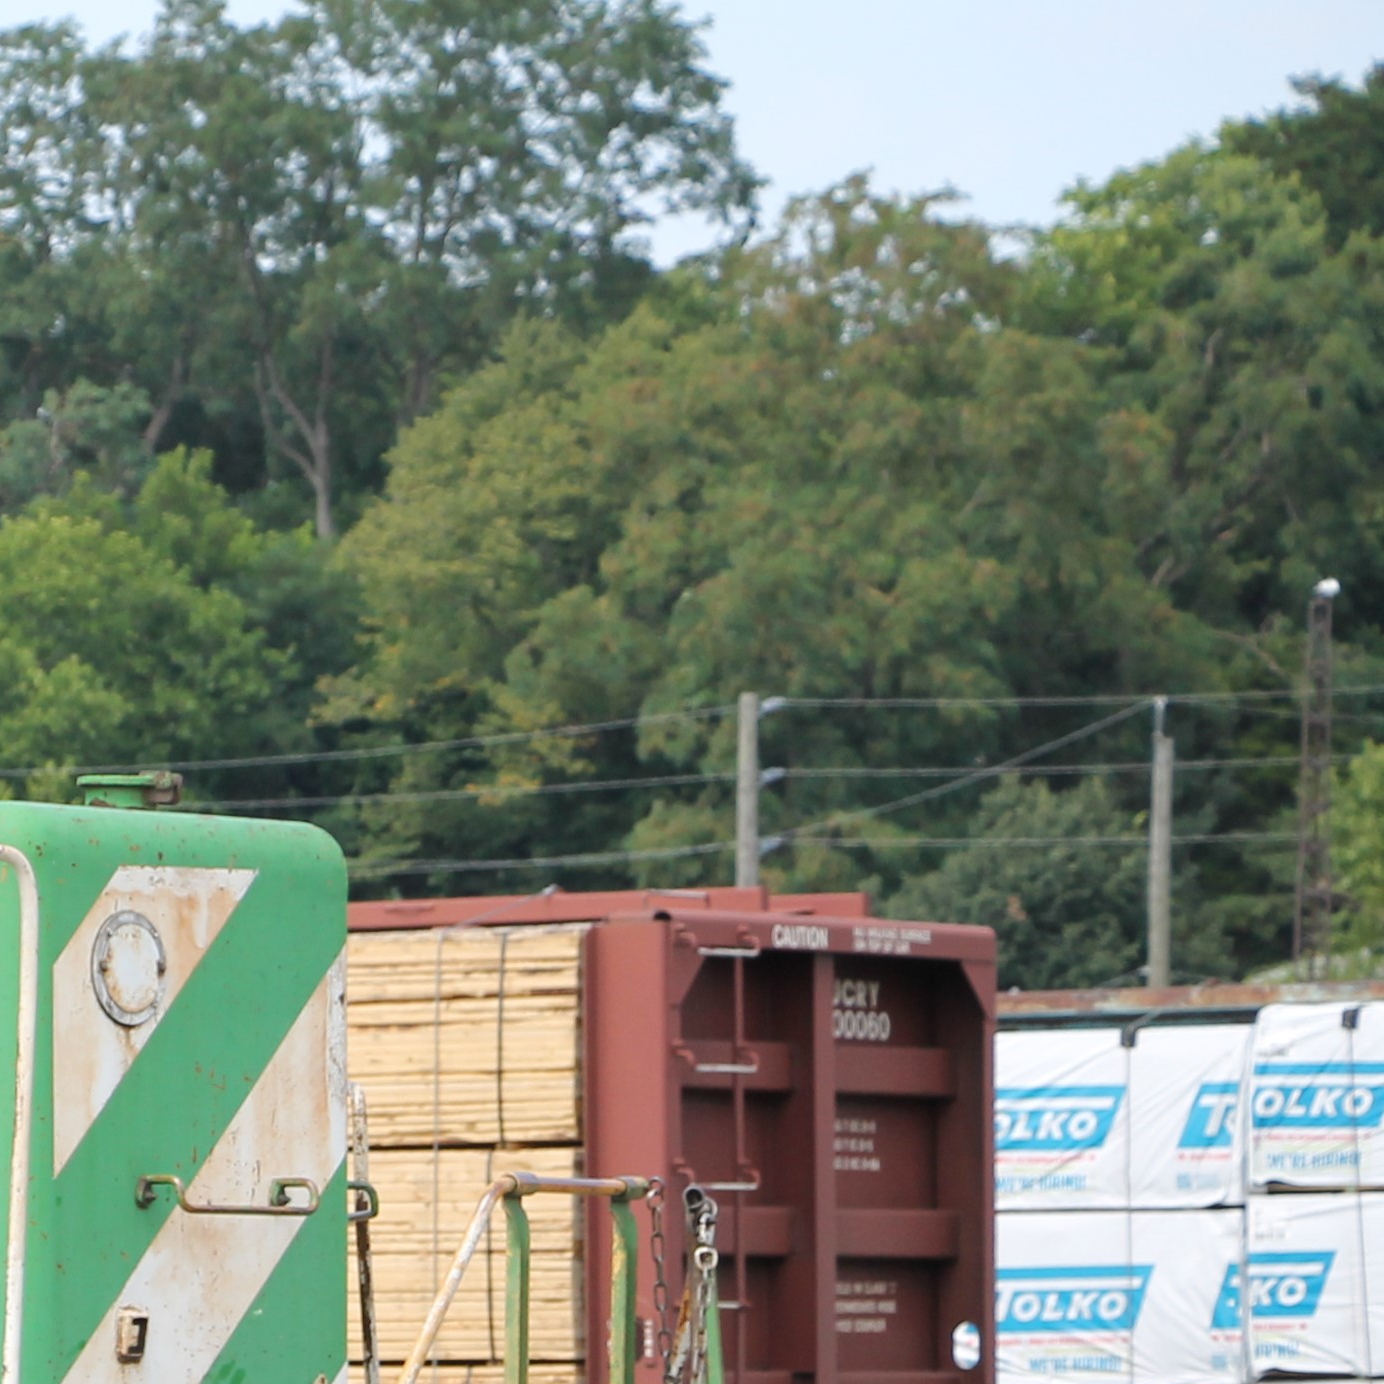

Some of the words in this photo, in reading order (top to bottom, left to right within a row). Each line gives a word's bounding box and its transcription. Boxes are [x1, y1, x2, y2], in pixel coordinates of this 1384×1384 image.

[771, 924, 829, 950] CAUTION
[1253, 1076, 1381, 1118] OLKO
[994, 1097, 1115, 1140] OLKO
